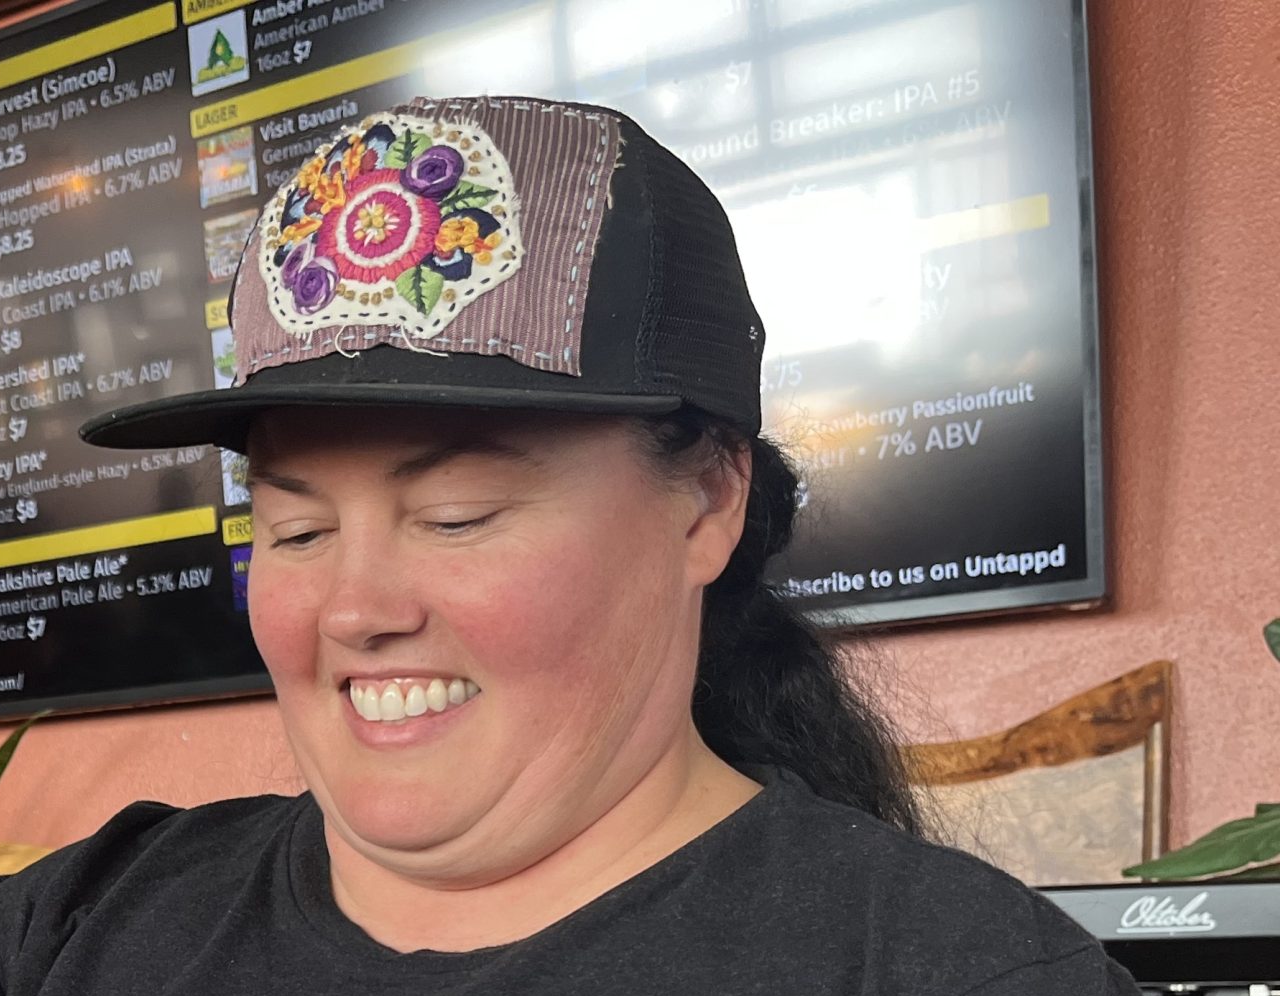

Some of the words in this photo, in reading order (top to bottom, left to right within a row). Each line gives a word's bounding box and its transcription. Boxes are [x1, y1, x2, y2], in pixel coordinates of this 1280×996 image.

[252, 0, 303, 26] Amber
[254, 14, 329, 50] American
[257, 52, 291, 73] 16oz
[292, 40, 312, 64] $7
[42, 57, 116, 103] (Simcoe)
[21, 109, 59, 134] Hazy
[61, 98, 88, 121] IPA
[100, 80, 139, 108] 6.5%
[141, 68, 176, 96] ABV
[195, 104, 238, 130] LAGER
[259, 117, 295, 142] Visit
[297, 99, 359, 131] Bavaria
[682, 122, 760, 164] round
[769, 98, 885, 144] Breaker:
[893, 81, 939, 114] IPA
[947, 69, 981, 100] #5
[102, 153, 124, 172] IPA
[124, 134, 177, 167] (Strata)
[64, 186, 92, 210] IPA
[104, 169, 145, 198] 6.7%
[147, 157, 182, 186] ABV
[105, 247, 133, 271] IPA
[2, 298, 46, 324] Coast
[49, 290, 76, 313] IPA
[88, 278, 126, 302] 6.1%
[128, 265, 162, 293] ABV
[0, 328, 22, 355] $8
[10, 387, 55, 412] Coast
[57, 380, 84, 401] IPA
[96, 368, 136, 393] 6.7%
[138, 358, 173, 384] ABV
[913, 382, 1035, 420] Passionfruit
[8, 416, 28, 442] $7
[876, 430, 916, 460] 7%
[924, 418, 983, 453] ABV
[7, 468, 95, 498] England-style
[97, 462, 130, 480] Hazy
[140, 452, 173, 472] 6.5%
[175, 446, 207, 465] ABV
[15, 498, 38, 524] $8
[56, 560, 91, 584] Pale
[61, 584, 95, 607] Pale
[97, 580, 124, 602] Ale
[136, 573, 176, 596] 5.3%
[178, 566, 213, 590] ABV
[786, 571, 865, 598] bscribe
[869, 568, 893, 589] to
[898, 565, 925, 585] us
[930, 561, 959, 581] on
[964, 543, 1066, 577] Untappd
[26, 614, 47, 641] $7
[1119, 891, 1217, 933] Oktober
